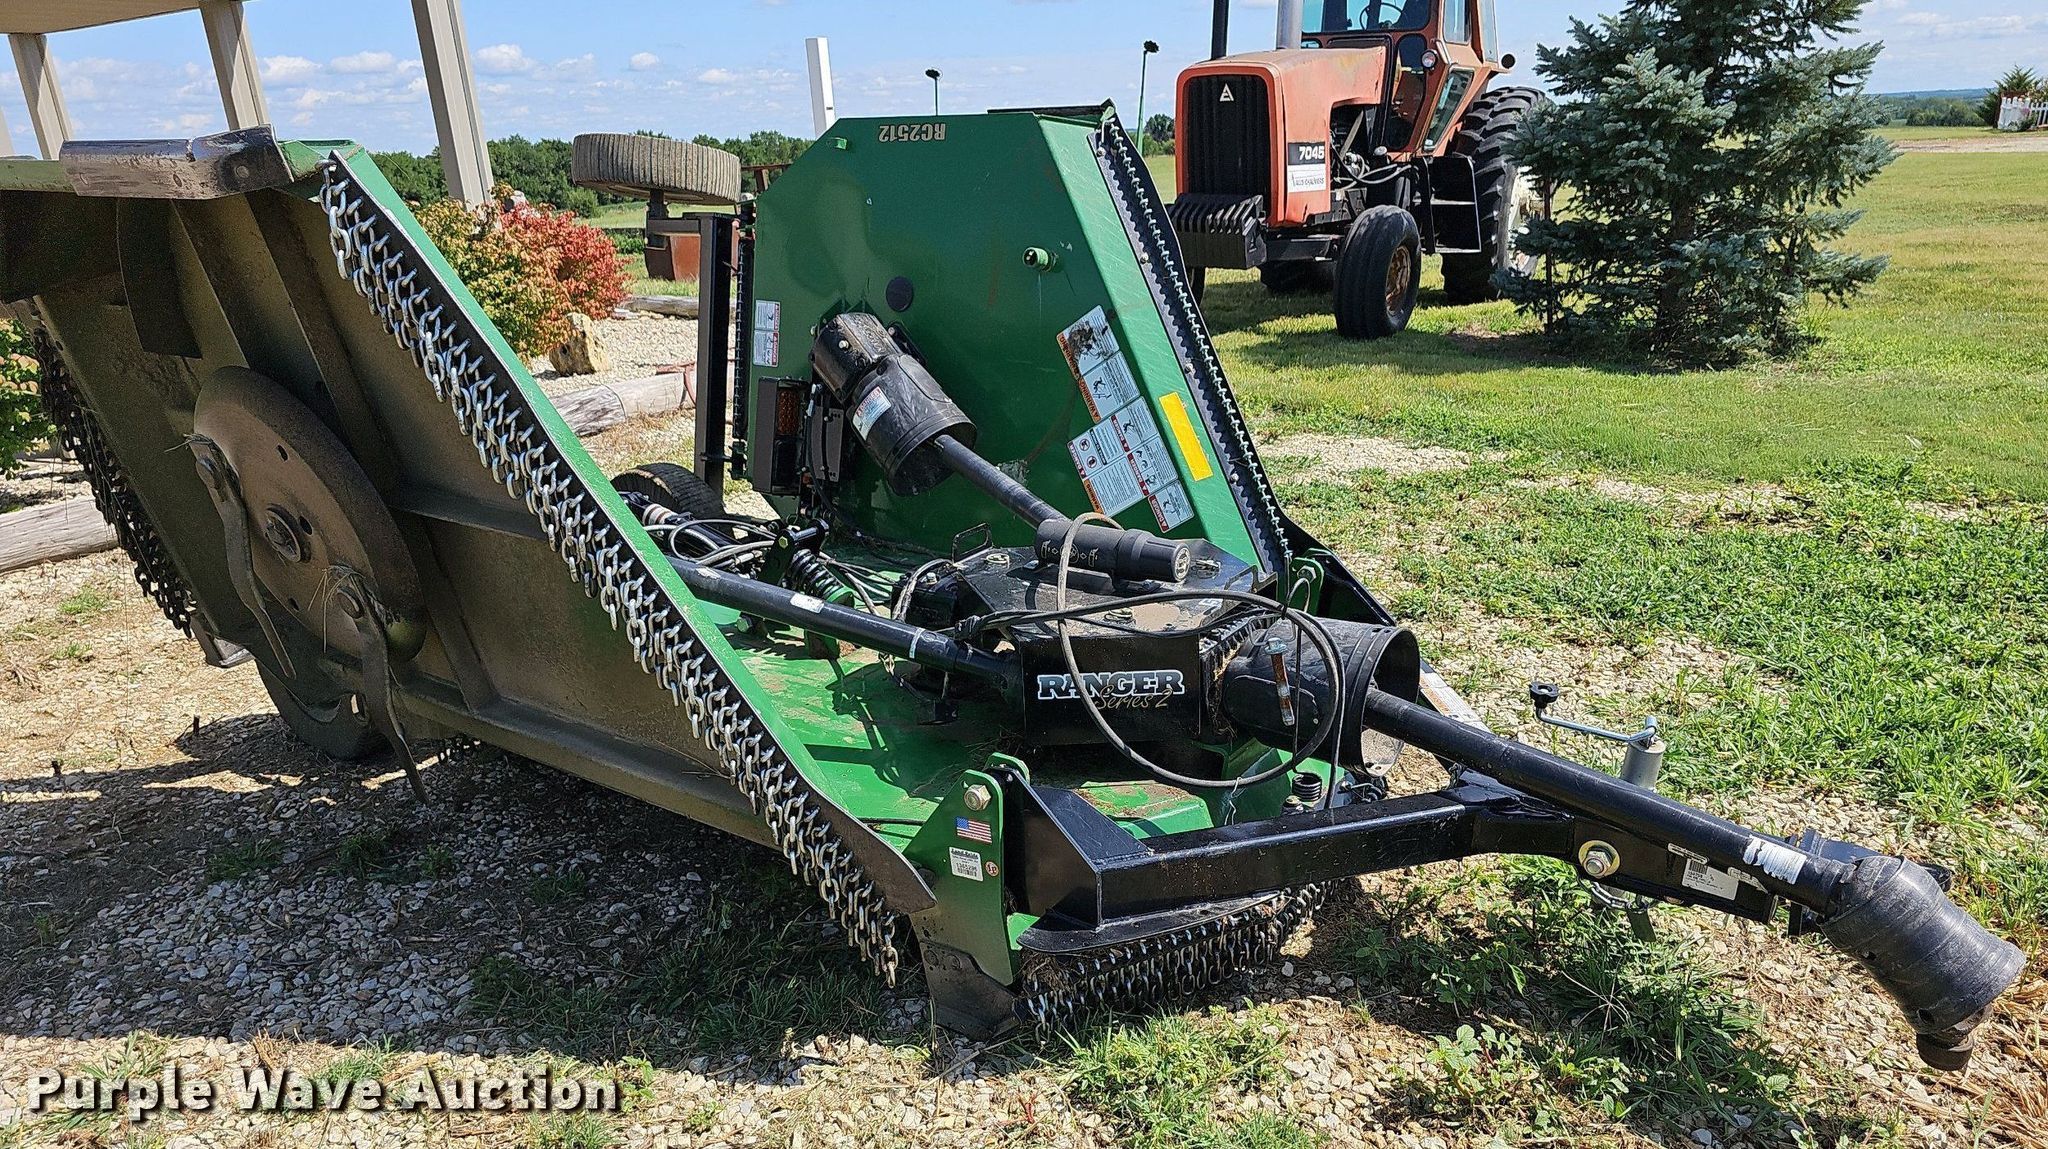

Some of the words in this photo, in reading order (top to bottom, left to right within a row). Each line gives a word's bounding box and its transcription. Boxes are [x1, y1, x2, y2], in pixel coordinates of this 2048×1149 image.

[878, 123, 946, 142] RC2512
[1298, 145, 1325, 161] 7045
[1078, 380, 1097, 413] WARNING
[1112, 419, 1124, 441] DANGER
[1068, 443, 1083, 469] DANGER
[1129, 458, 1143, 482] DANGER
[1085, 482, 1100, 510] WARNING
[1150, 497, 1165, 522] DANGER
[1037, 669, 1185, 701] RANGER
[1094, 685, 1154, 711] Series
[1155, 688, 1173, 708] 2
